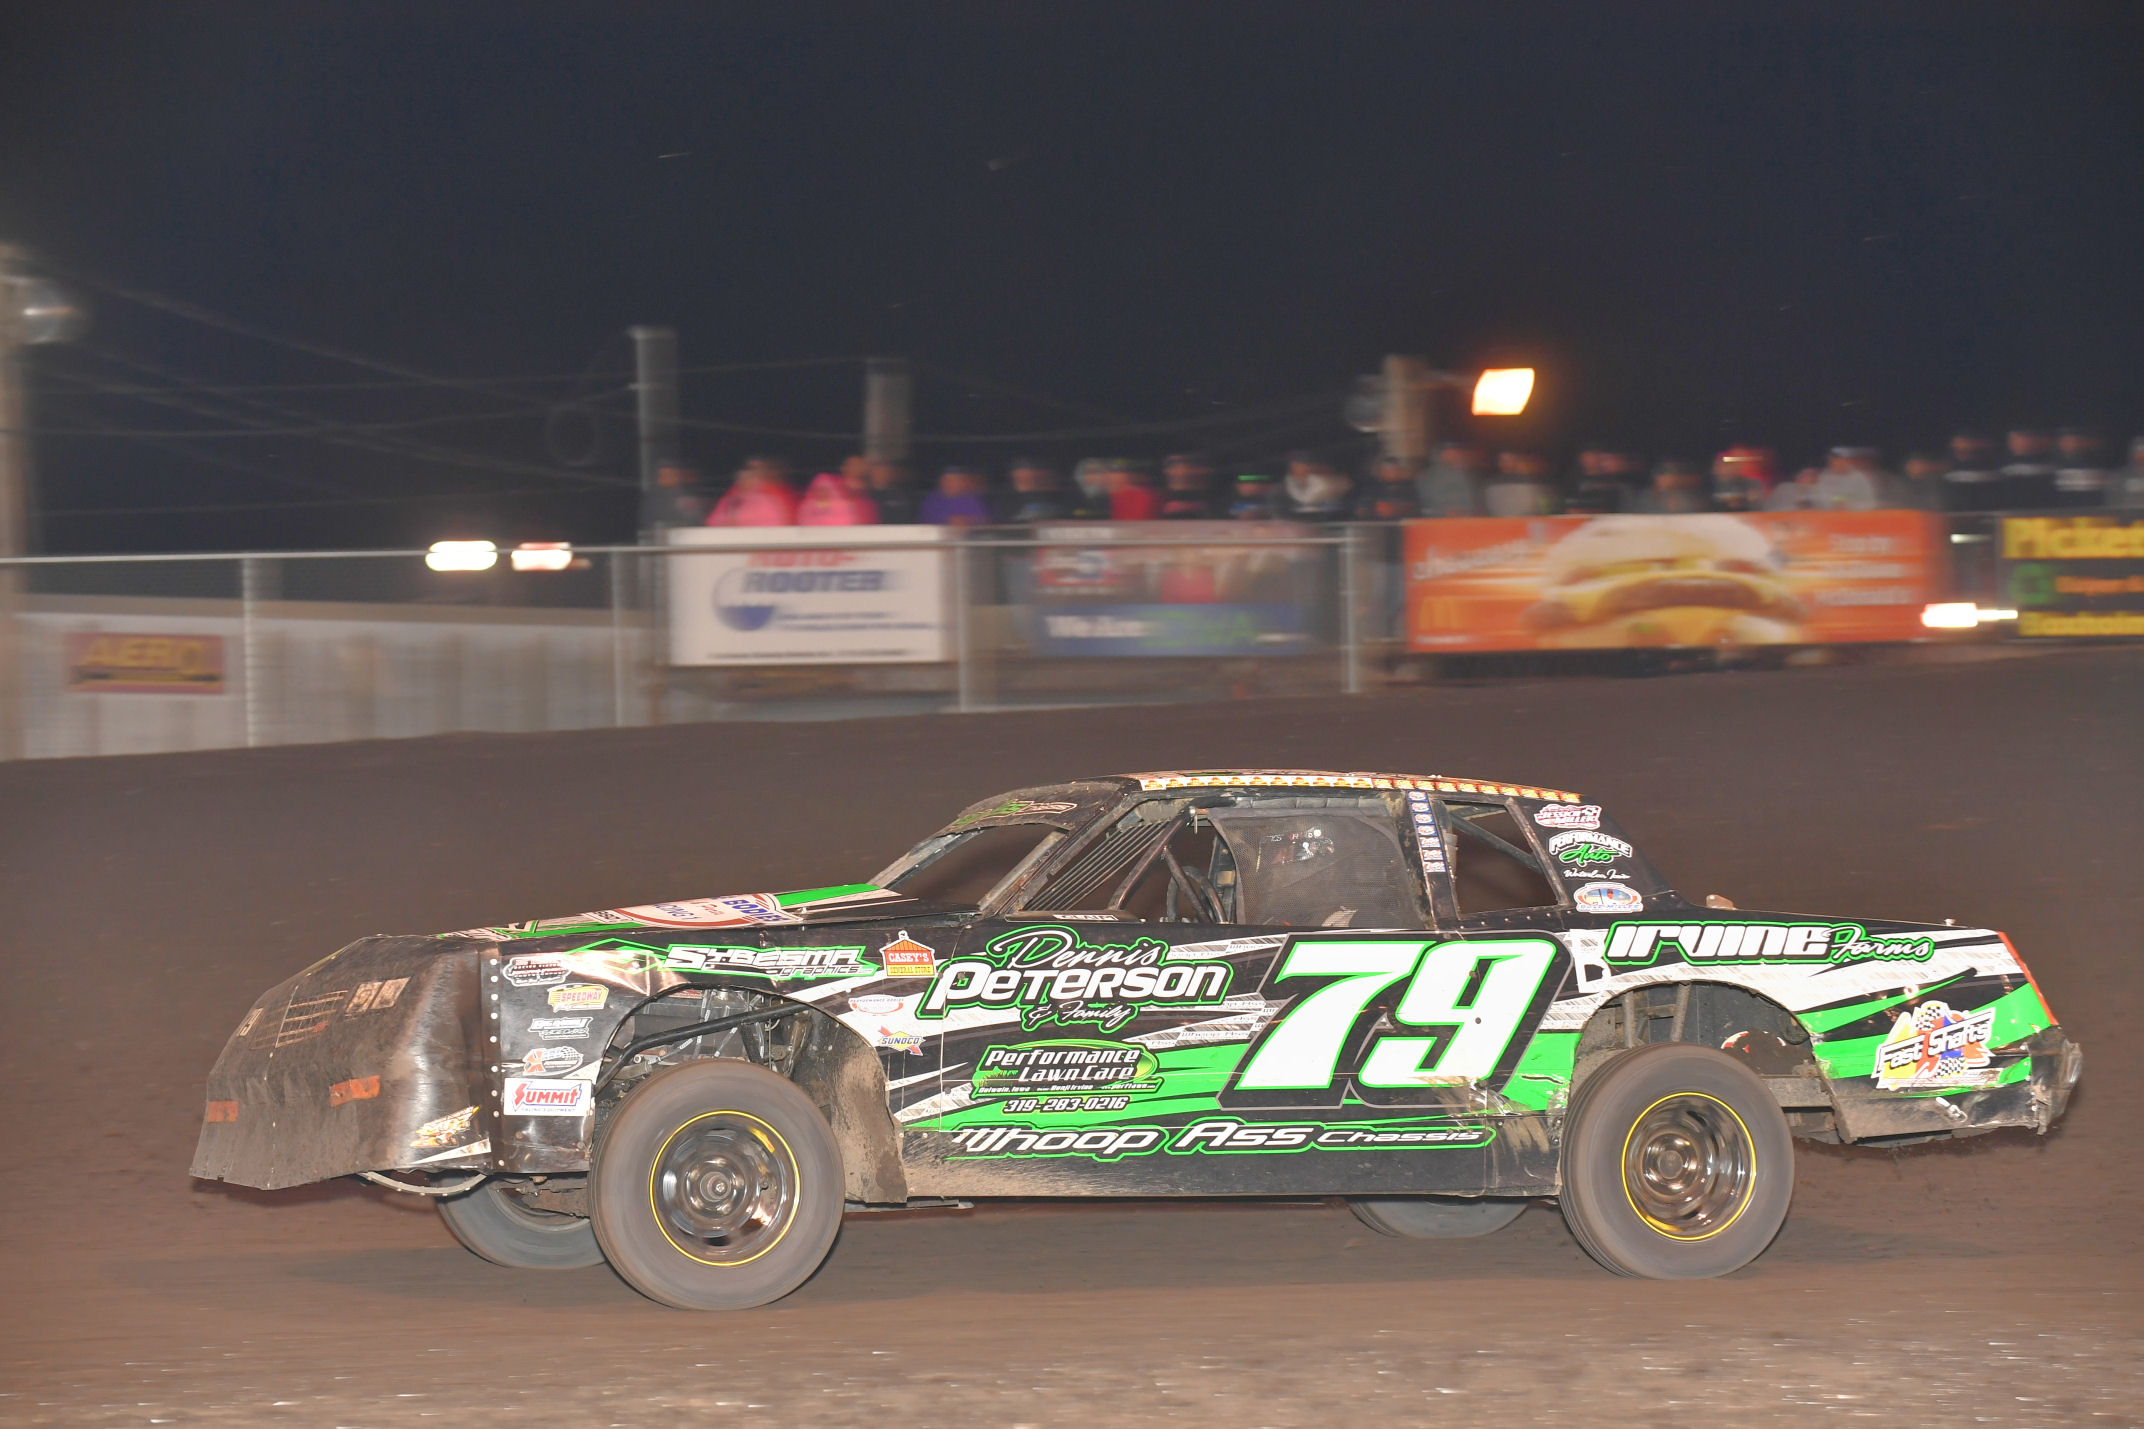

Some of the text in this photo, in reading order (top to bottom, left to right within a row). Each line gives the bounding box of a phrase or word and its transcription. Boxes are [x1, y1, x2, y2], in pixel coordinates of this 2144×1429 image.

[742, 570, 887, 593] ROOTER
[1550, 831, 1630, 854] PERFORMANCE
[1561, 843, 1618, 864] Auto
[993, 930, 1161, 969] Dennis
[1824, 926, 1930, 958] Farms
[664, 947, 860, 968] SYBESMA
[889, 953, 930, 962] CASEY'S
[777, 965, 860, 978] graphics
[561, 991, 603, 1002] SPEEDWAY
[1029, 1001, 1132, 1027] & Family
[1233, 939, 1557, 1090] 79
[881, 1037, 921, 1045] SUNOCO
[1876, 1013, 1992, 1074] Fast Shafts
[985, 1050, 1140, 1066] Performance
[1018, 1065, 1137, 1082] Lawn Care
[1004, 1096, 1128, 1112] 319-283-0216
[952, 1122, 1483, 1154] Whoop Ass Chassis
